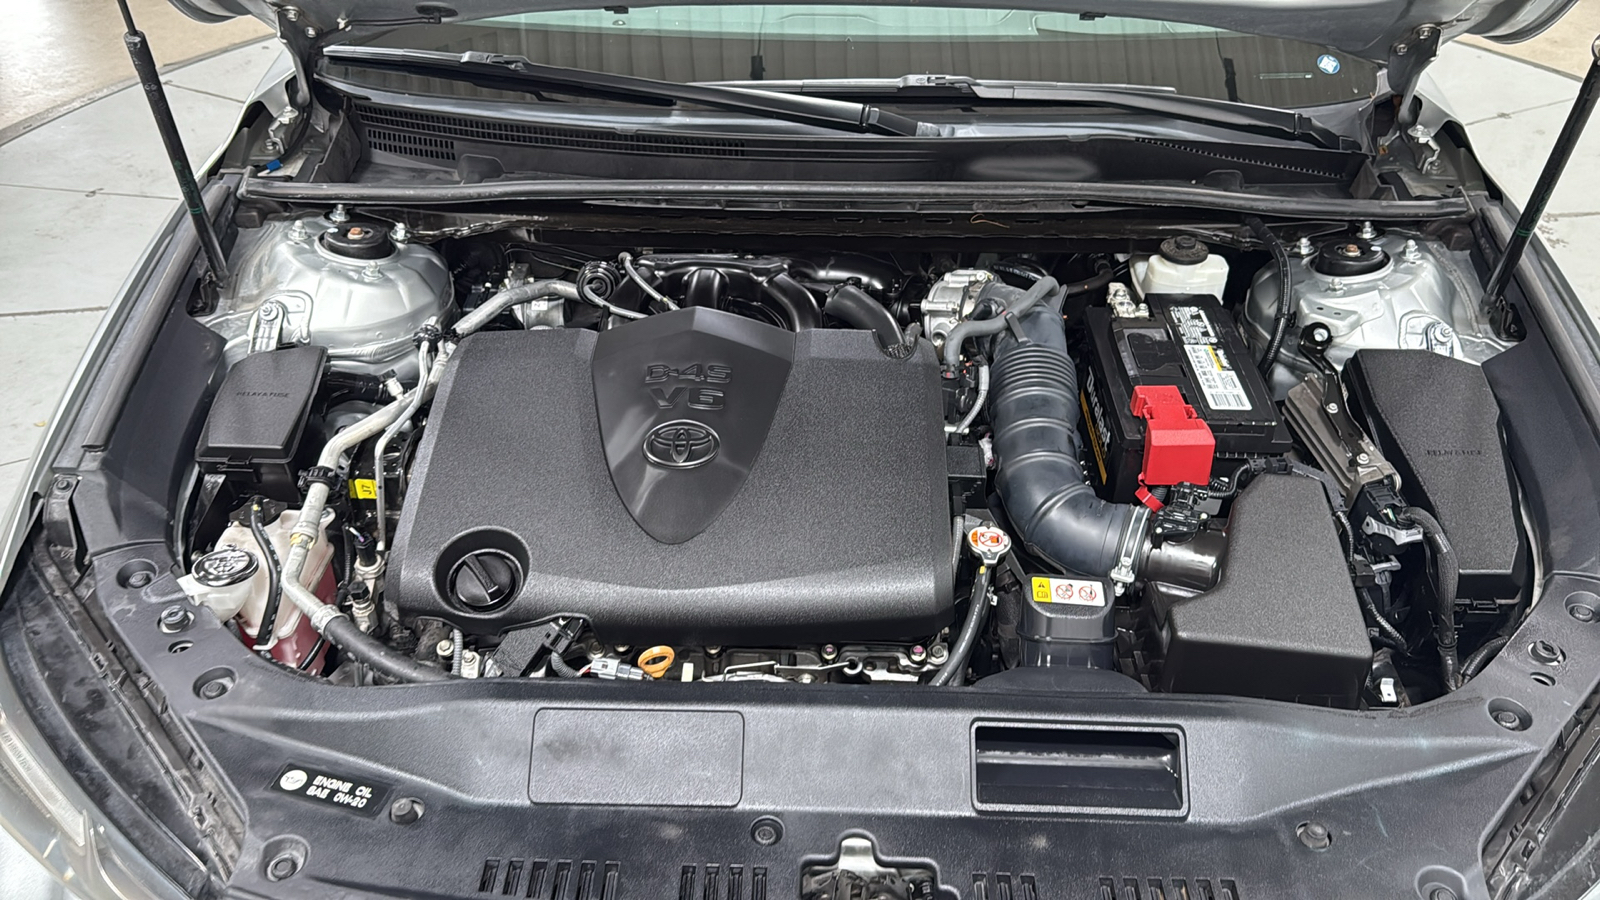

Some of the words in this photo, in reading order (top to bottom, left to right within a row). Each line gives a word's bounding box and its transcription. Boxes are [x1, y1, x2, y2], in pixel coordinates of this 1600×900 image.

[645, 363, 733, 384] D-4S
[649, 386, 726, 411] V6
[1086, 365, 1111, 452] Duralast
[361, 483, 373, 496] J7
[306, 785, 331, 799] SAE
[333, 792, 368, 808] 0W-20
[312, 775, 353, 793] ENGINE
[355, 786, 373, 798] OIL
